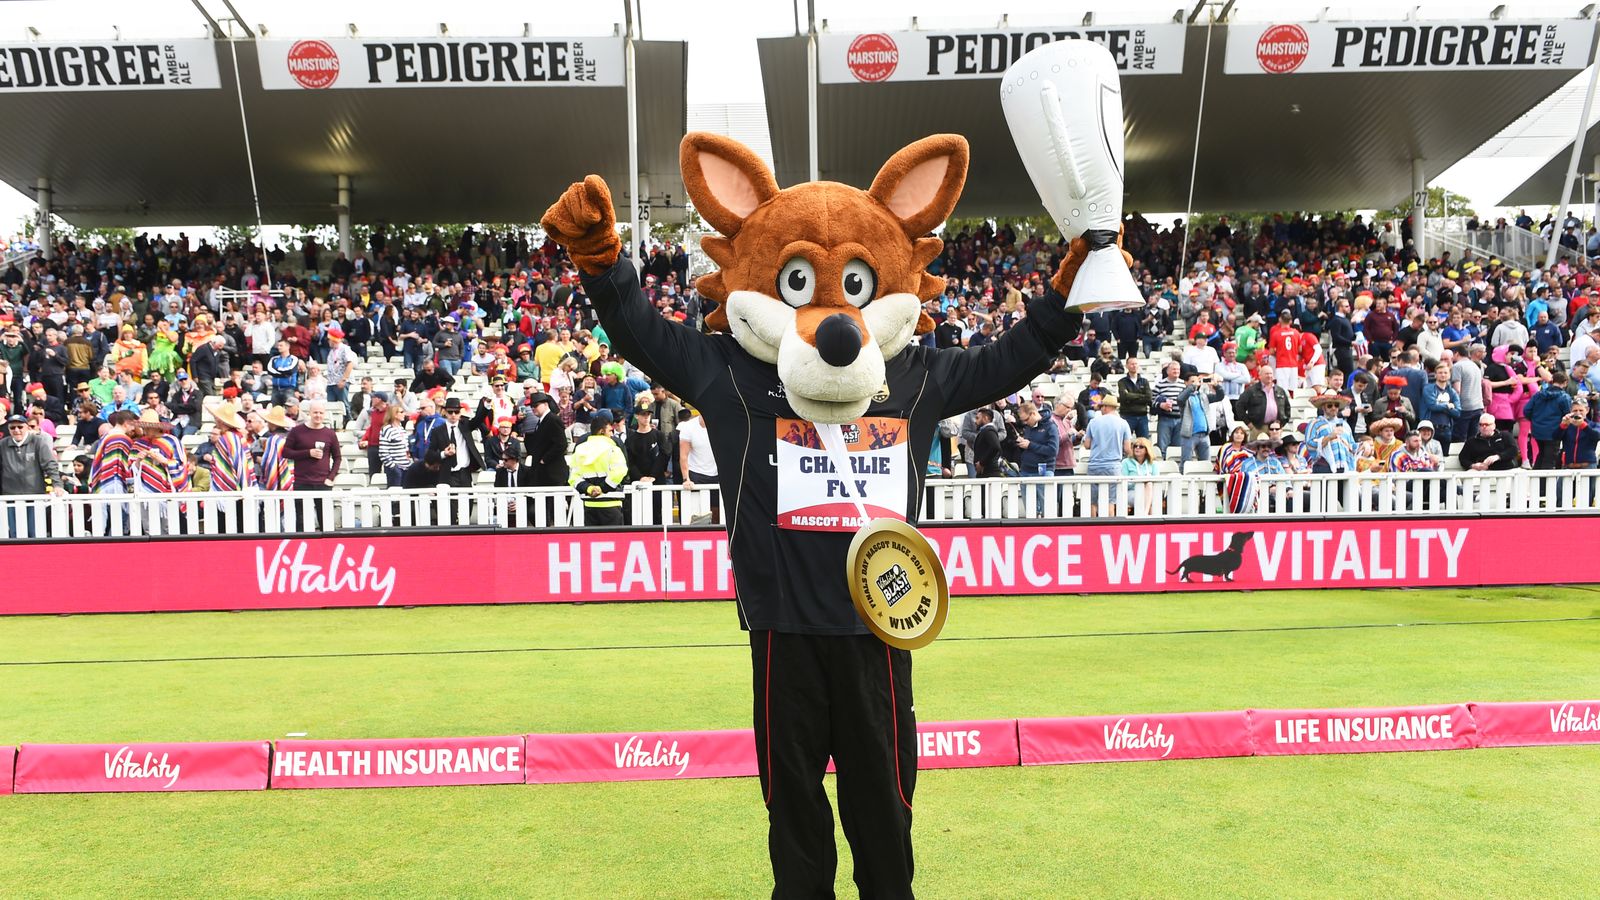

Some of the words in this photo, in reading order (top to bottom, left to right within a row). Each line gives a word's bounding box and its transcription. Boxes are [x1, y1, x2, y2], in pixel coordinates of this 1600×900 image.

[573, 42, 584, 82] AMBER
[926, 30, 1131, 76] PEDIE
[1132, 29, 1146, 70] AMBER
[1144, 47, 1156, 70] ALE
[1331, 25, 1543, 68] PEDIGREE
[1540, 24, 1558, 65] AMBER
[1551, 41, 1566, 65] ALE
[164, 44, 181, 85] AMBER
[178, 61, 192, 85] ALE
[362, 42, 570, 83] PEDIGREE
[585, 59, 596, 82] ALE
[638, 205, 650, 221] 25
[1415, 191, 1428, 207] 27
[35, 211, 48, 226] 24
[1285, 336, 1292, 351] 6
[842, 430, 859, 440] AST
[791, 516, 839, 527] MASCOT
[842, 517, 868, 528] RAC
[255, 539, 396, 606] Vitality
[861, 558, 869, 576] DAY
[866, 540, 890, 560] MASCOT
[891, 541, 911, 557] RACE
[910, 554, 926, 576] 2018
[1253, 527, 1469, 583] VITALITY
[883, 573, 908, 601] BLAST
[888, 595, 932, 630] WINNER
[1104, 718, 1175, 757] Vitality
[1275, 719, 1320, 744] LIFE
[1327, 714, 1453, 742] INSURANCE
[104, 745, 181, 788] Vitality
[274, 749, 371, 777] HEALTH
[377, 746, 519, 775] INSURANCE
[614, 735, 690, 776] Vitality
